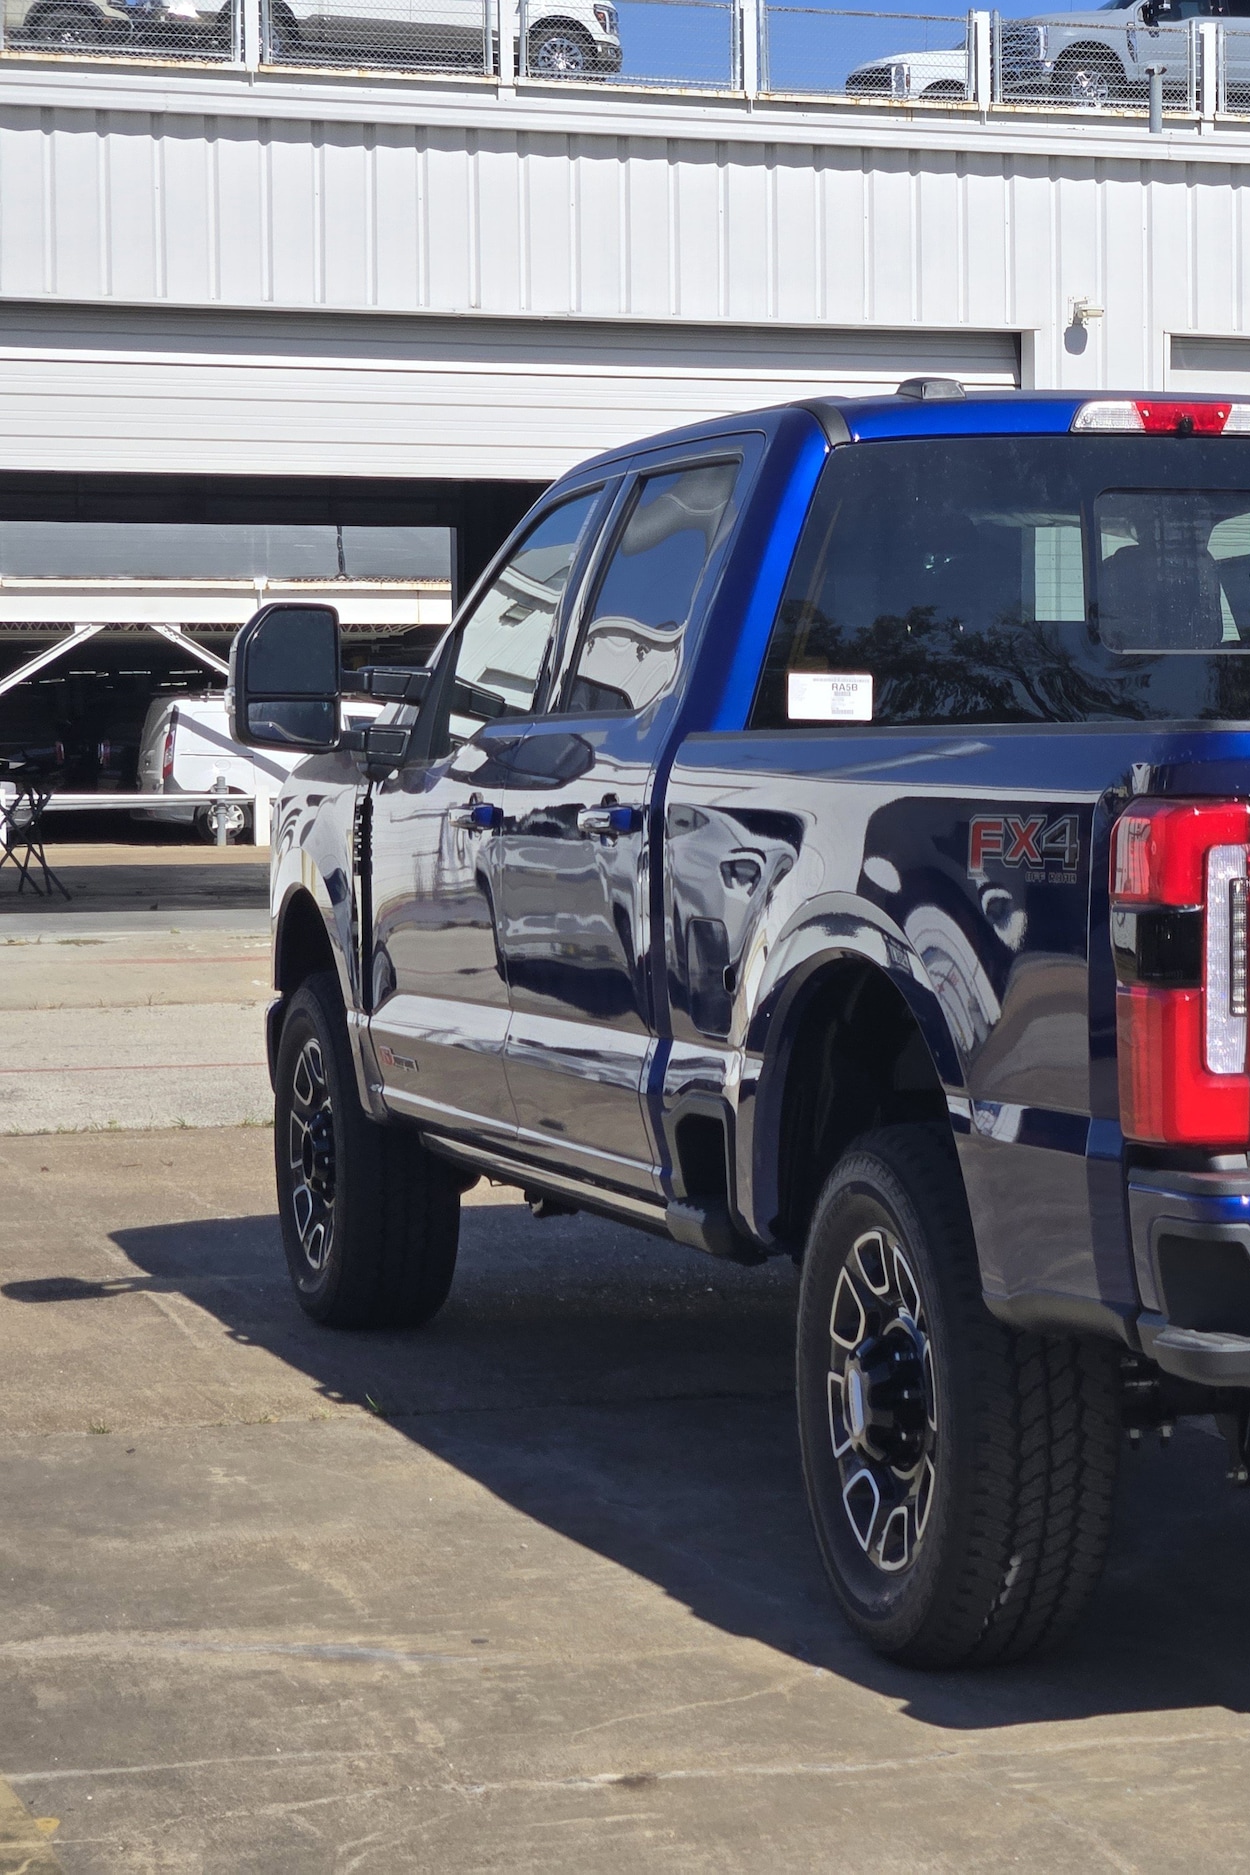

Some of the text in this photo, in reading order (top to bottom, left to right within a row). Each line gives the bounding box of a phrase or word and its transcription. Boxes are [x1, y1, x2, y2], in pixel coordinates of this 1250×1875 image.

[831, 683, 858, 691] RA5B
[967, 814, 1080, 880] FX4
[1025, 871, 1077, 884] OFF ROAD
